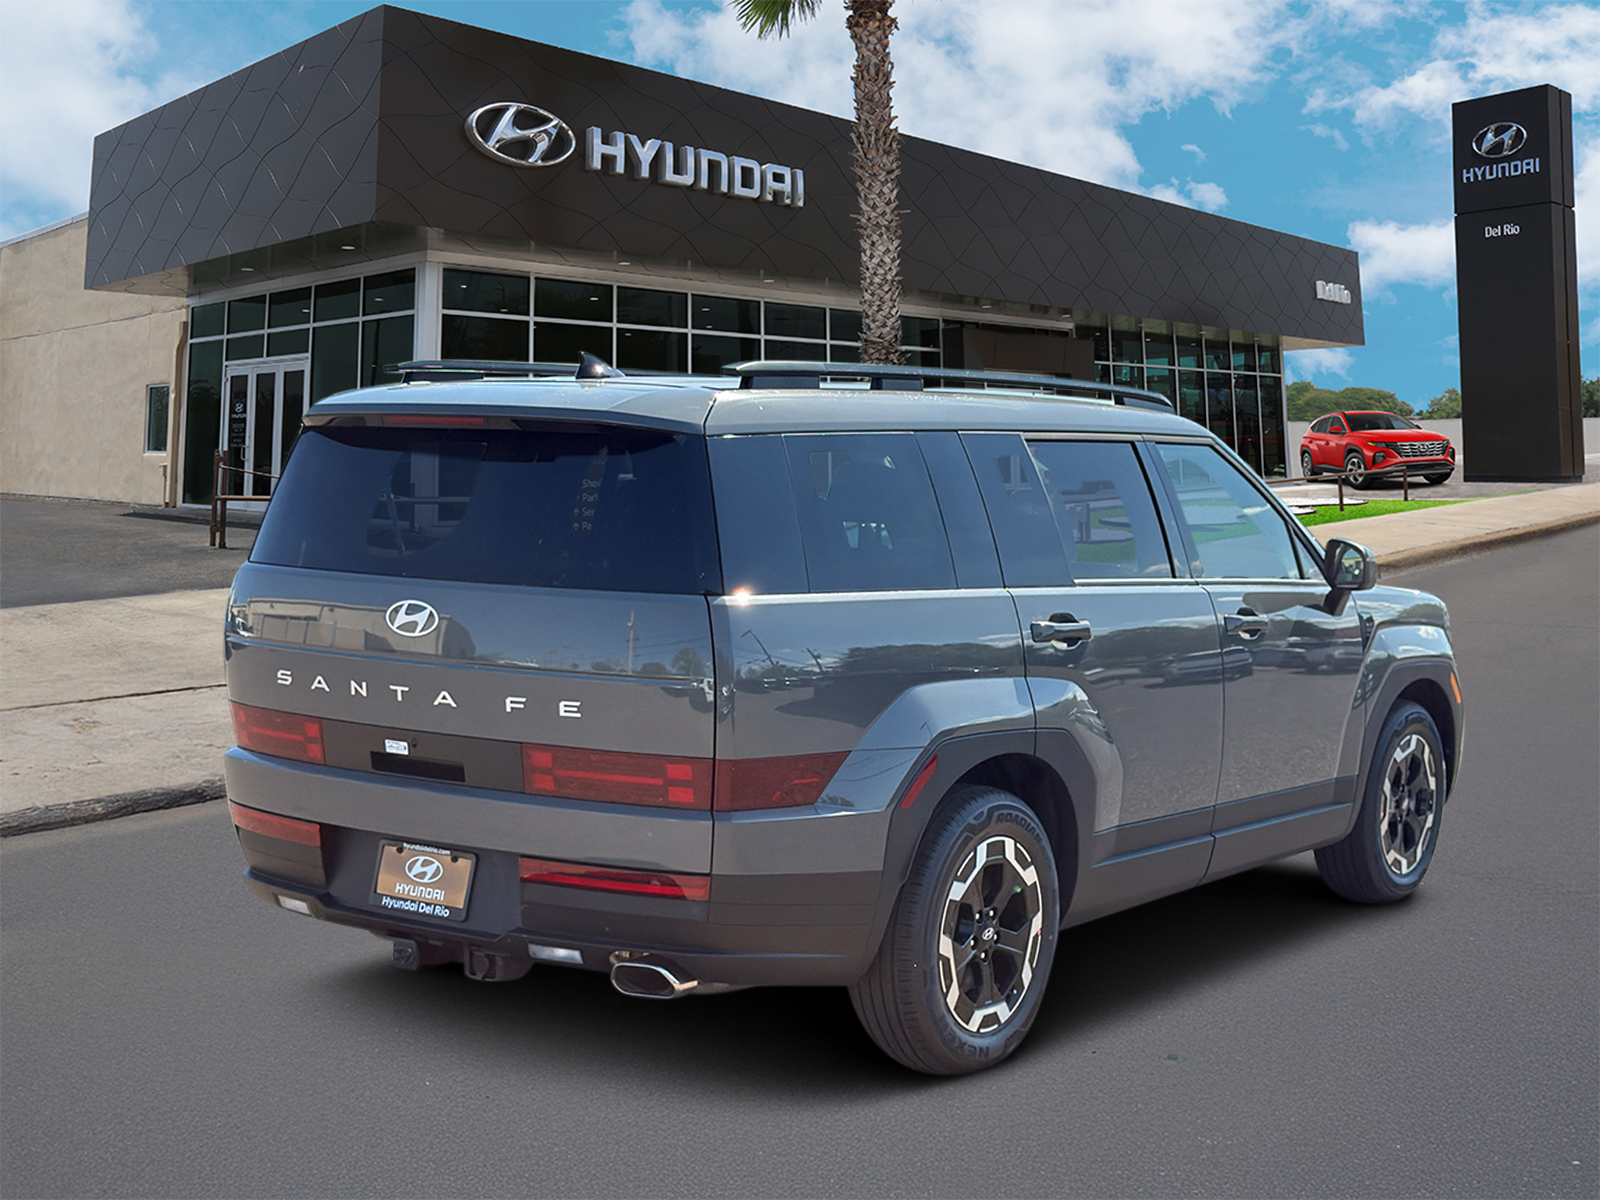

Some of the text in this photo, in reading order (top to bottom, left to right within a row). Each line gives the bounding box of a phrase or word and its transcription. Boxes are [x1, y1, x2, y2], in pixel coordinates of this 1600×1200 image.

[586, 126, 804, 207] HYUNDAI
[1462, 157, 1540, 183] HYUNDAI
[1484, 223, 1520, 238] Del Rio
[276, 669, 582, 718] SANTA FE
[394, 882, 446, 902] HYUNDAI
[382, 896, 450, 917] Hyundai Del Rio
